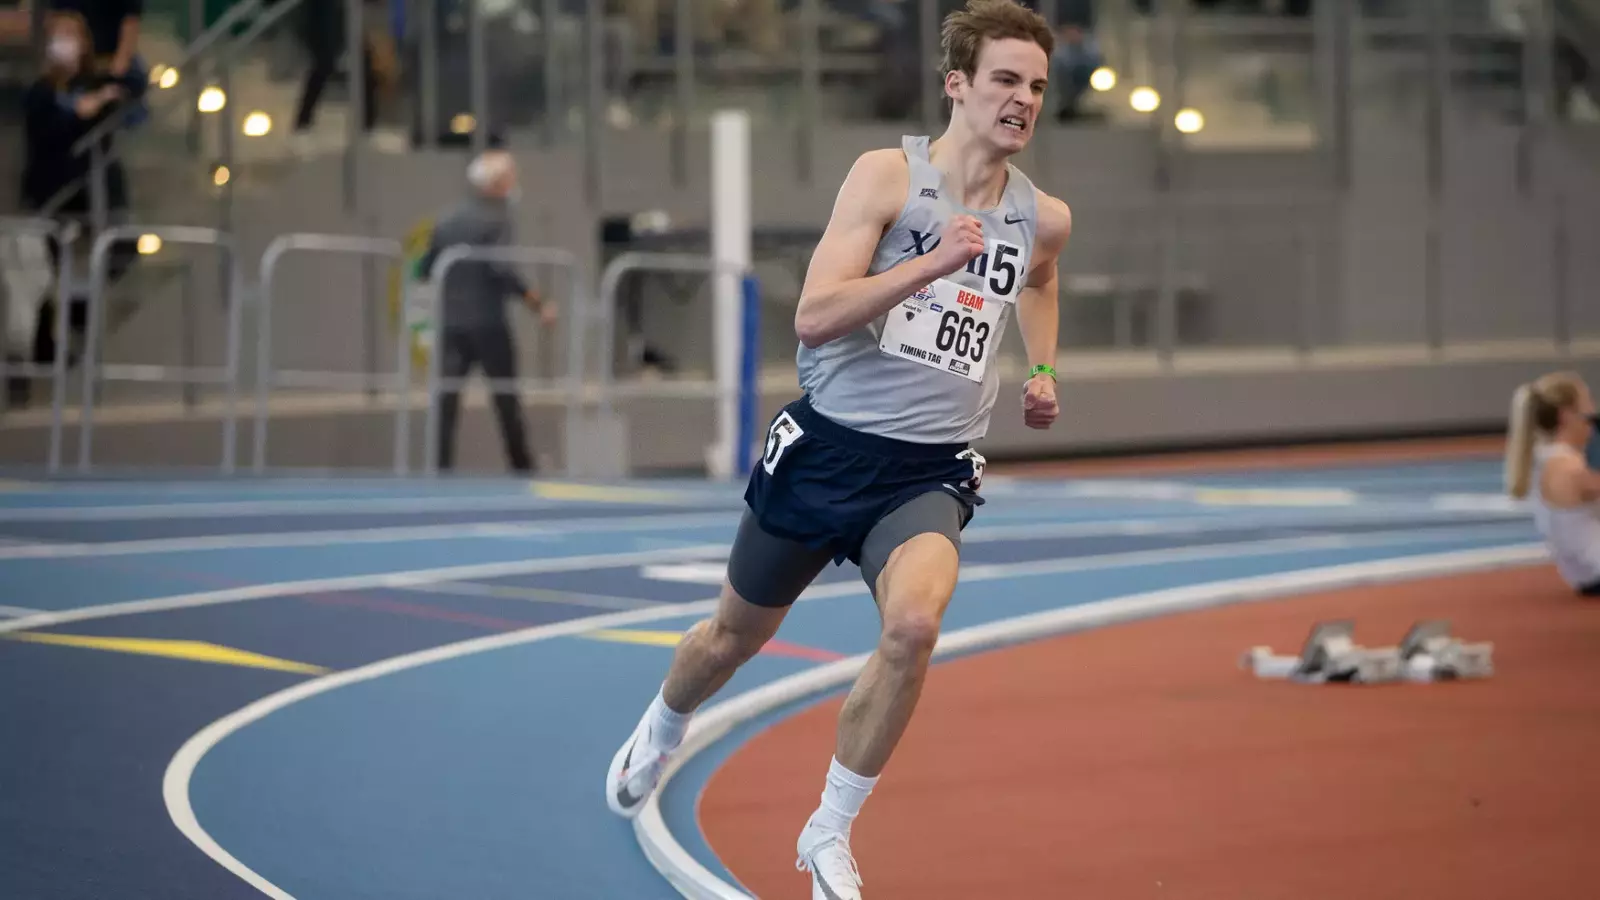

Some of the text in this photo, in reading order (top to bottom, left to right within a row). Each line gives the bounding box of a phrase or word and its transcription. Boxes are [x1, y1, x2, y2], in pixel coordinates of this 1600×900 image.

[990, 244, 1019, 296] 5
[957, 289, 985, 311] BEAM
[900, 343, 942, 364] TIMING TAG
[935, 310, 990, 363] 663
[765, 417, 794, 464] 5
